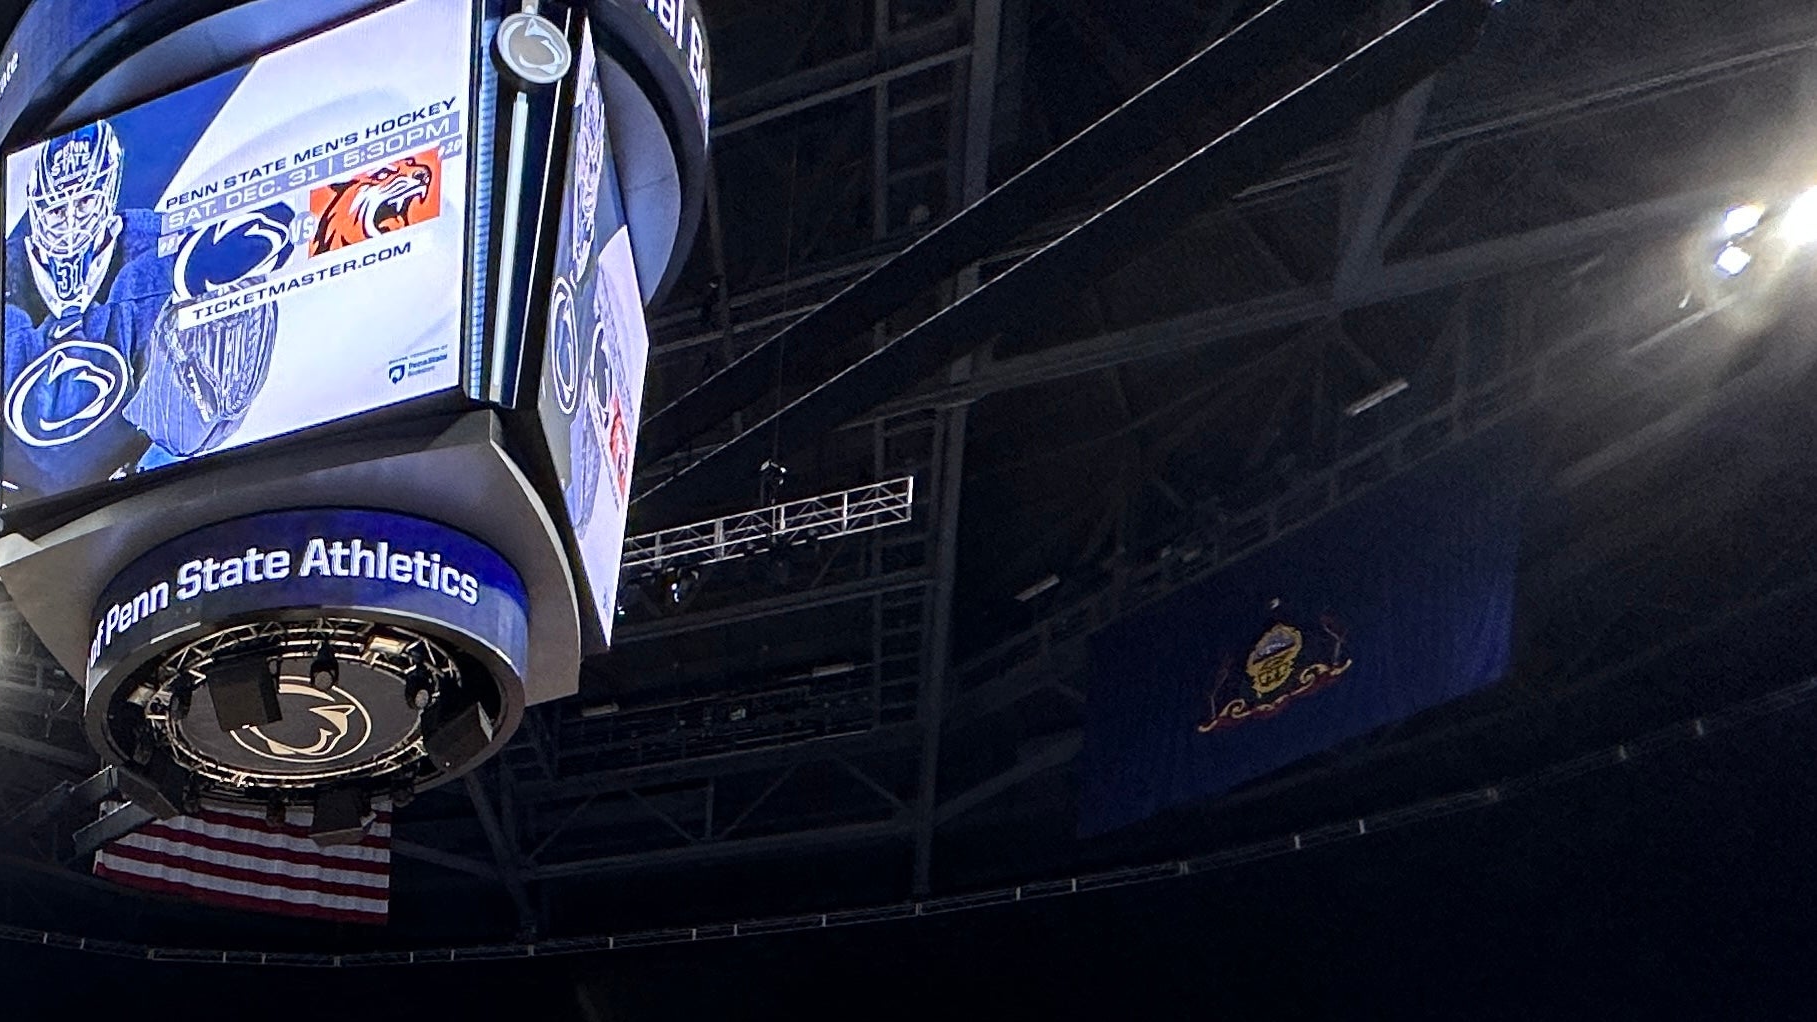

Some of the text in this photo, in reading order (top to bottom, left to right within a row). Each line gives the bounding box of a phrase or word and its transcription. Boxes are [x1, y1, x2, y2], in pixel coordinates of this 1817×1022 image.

[59, 140, 91, 164] PENN
[166, 96, 457, 211] PENN STATE MEN'S HOCKEY
[167, 116, 453, 230] SAT. DEC. 31 5:30PM
[288, 213, 316, 242] VS
[55, 255, 84, 299] 31
[192, 241, 413, 322] TICKETMASTER.COM
[106, 581, 170, 646] Penn
[175, 544, 292, 601] State
[296, 536, 480, 606] Athletics
